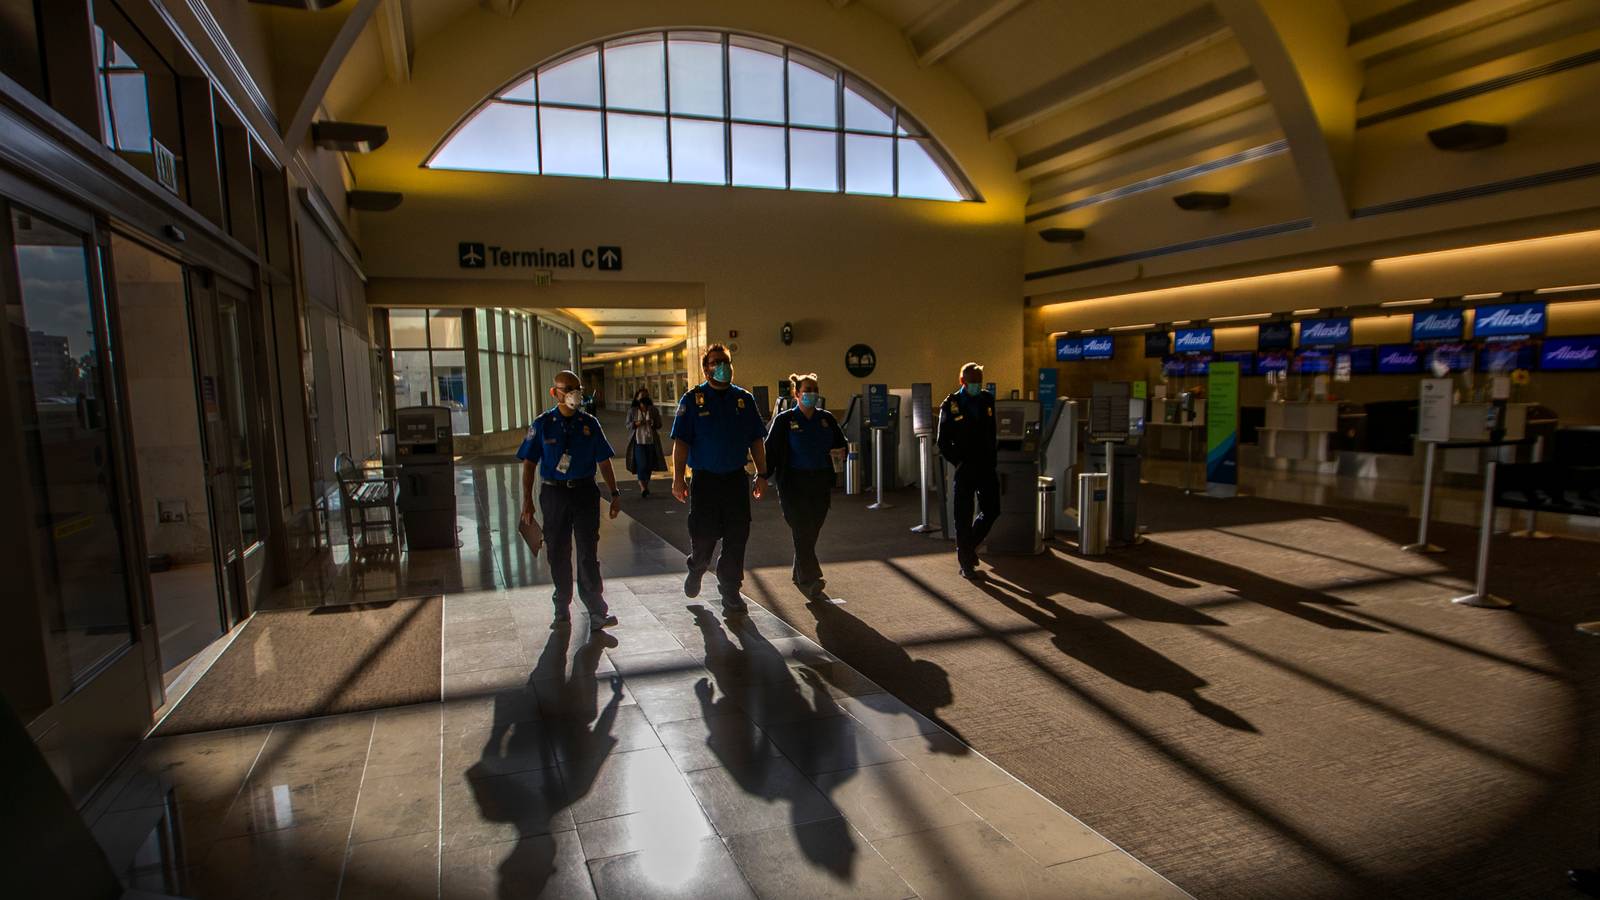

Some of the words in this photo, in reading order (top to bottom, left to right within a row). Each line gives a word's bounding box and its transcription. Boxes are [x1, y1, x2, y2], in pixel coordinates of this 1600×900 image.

[488, 246, 575, 268] Terminal
[582, 249, 595, 268] C
[1415, 313, 1461, 331] Alaska
[1478, 308, 1543, 328] Alaska
[1304, 322, 1349, 337] Alaska
[1083, 339, 1112, 351] Alaska
[1177, 332, 1212, 345] Alaska
[1058, 344, 1083, 355] Alaska
[1546, 345, 1598, 360] Alaska
[1381, 352, 1417, 365] Alaska
